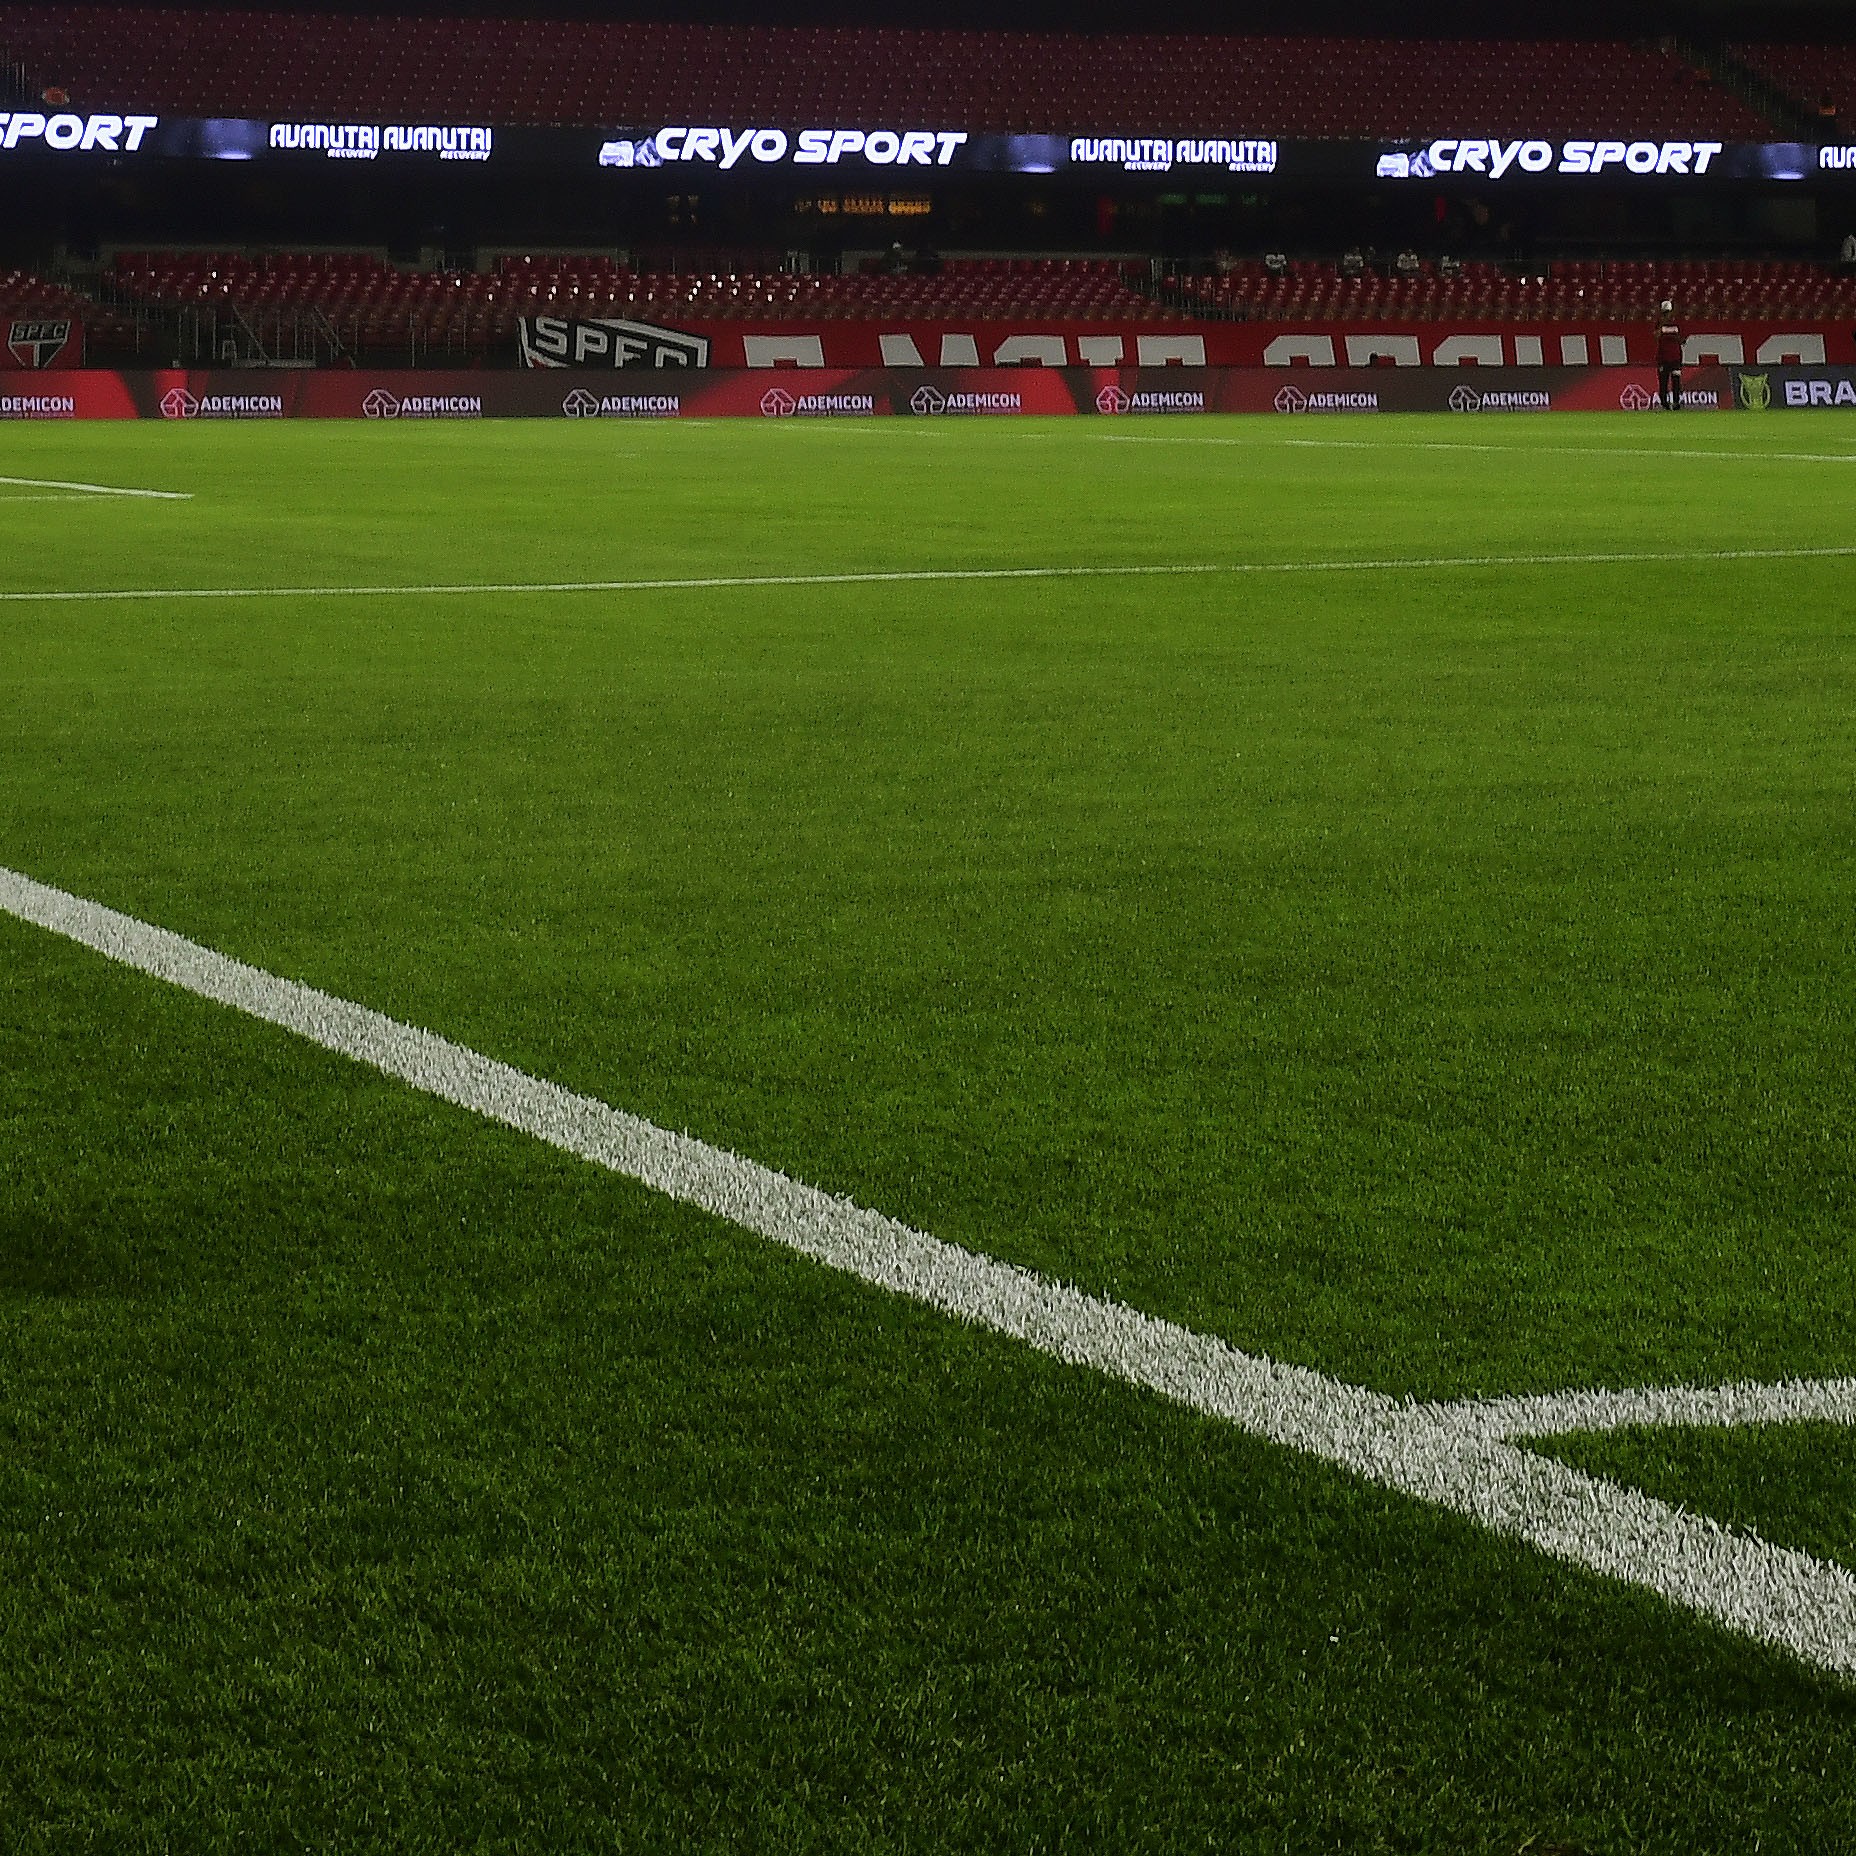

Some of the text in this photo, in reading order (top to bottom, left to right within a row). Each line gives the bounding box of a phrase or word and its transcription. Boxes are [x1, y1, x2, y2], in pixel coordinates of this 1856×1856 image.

[270, 124, 492, 152] AVANUTRI AVANUTRI
[656, 127, 967, 169] CRYO SPORT
[1071, 138, 1277, 165] AVANUTRI AVANUTRI
[1429, 140, 1722, 178] CRYO SPORT
[201, 396, 282, 411] ADEMICON
[401, 397, 481, 412] ADEMICON
[601, 396, 679, 411] ADEMICON
[798, 395, 873, 410] ADEMICON
[947, 393, 1020, 408] ADEMICON
[1131, 392, 1204, 407] ADEMICON
[1308, 392, 1378, 407] ADEMICON
[1482, 391, 1549, 406] ADEMICON
